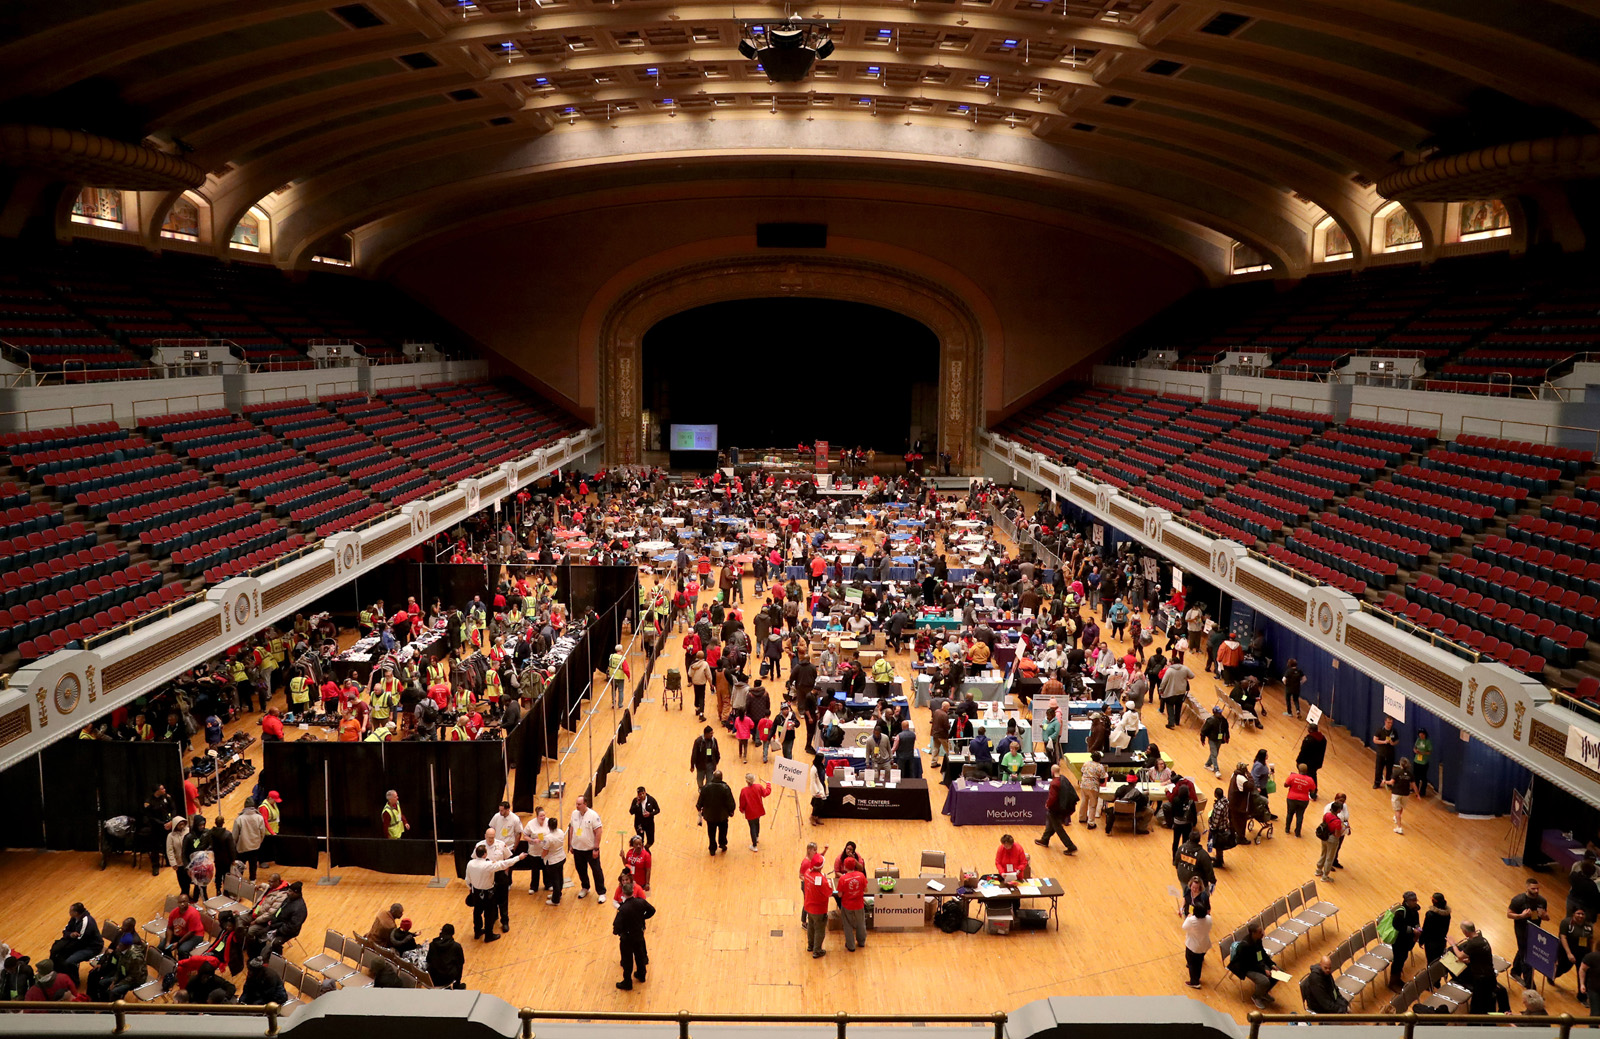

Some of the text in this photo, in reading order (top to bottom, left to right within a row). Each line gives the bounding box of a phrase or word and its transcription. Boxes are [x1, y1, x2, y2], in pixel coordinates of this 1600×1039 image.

[778, 763, 802, 775] Provider
[783, 774, 795, 782] Fair
[986, 809, 1033, 818] Medworks
[1532, 944, 1550, 957] PATIENT
